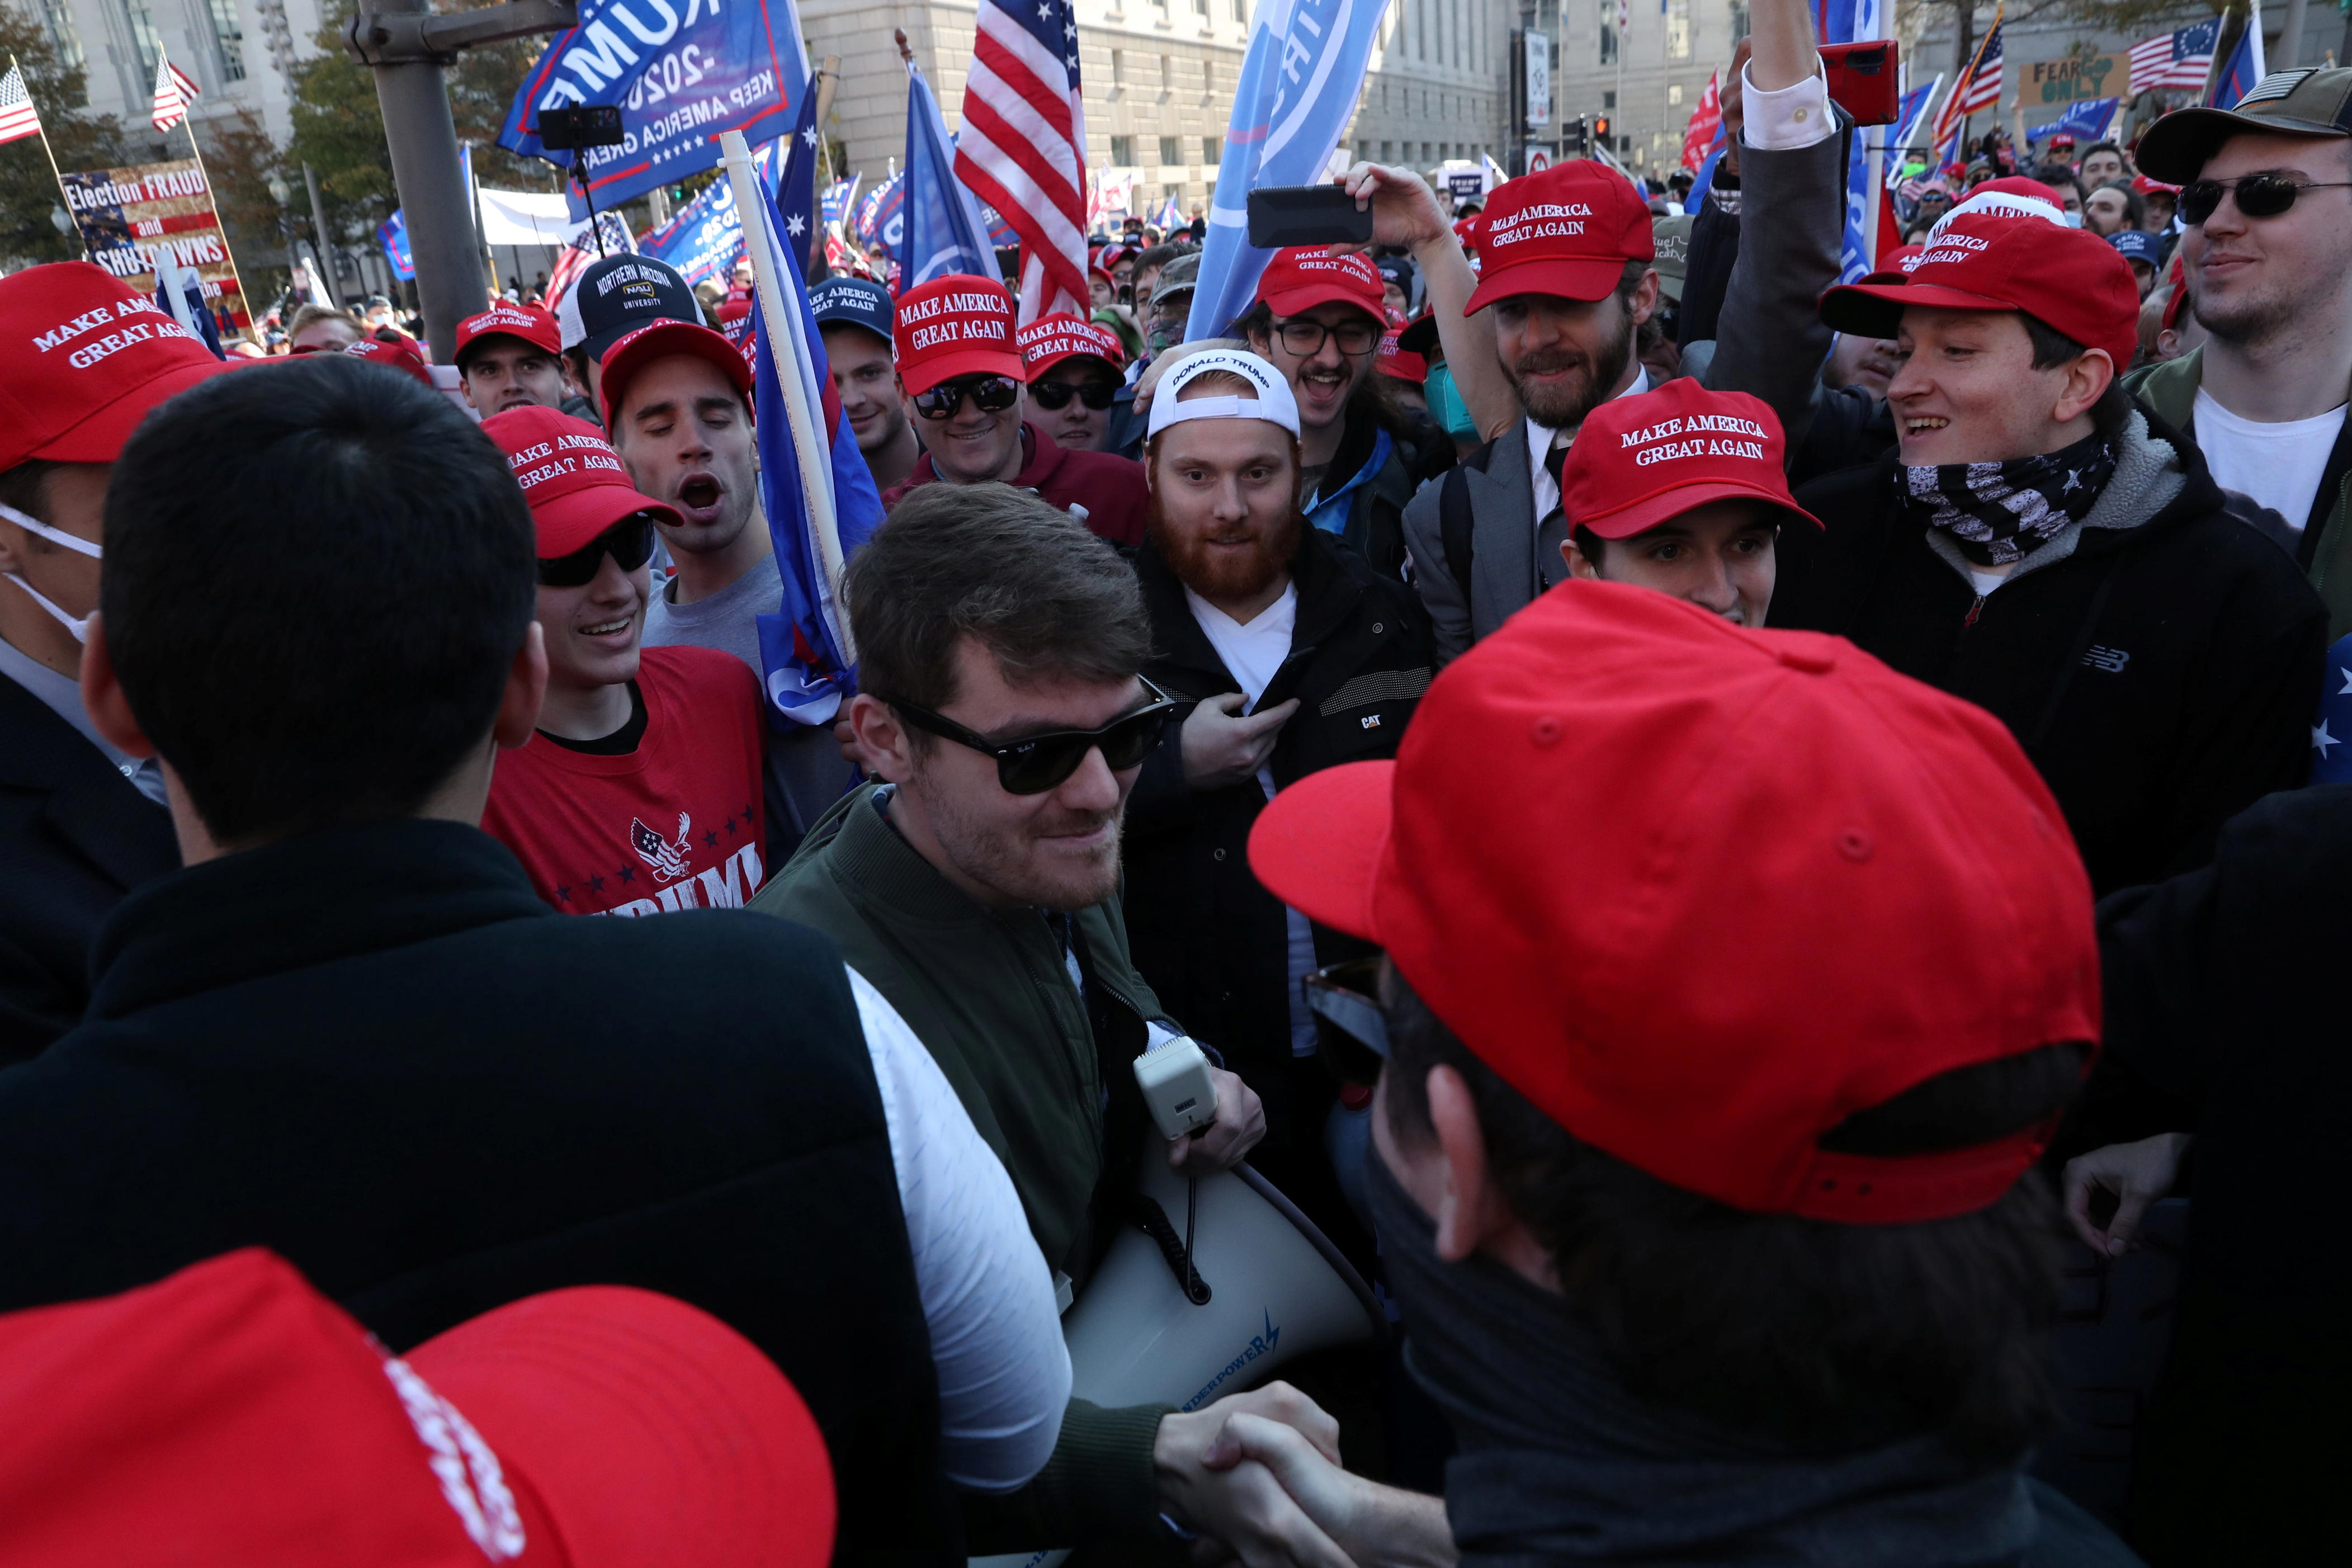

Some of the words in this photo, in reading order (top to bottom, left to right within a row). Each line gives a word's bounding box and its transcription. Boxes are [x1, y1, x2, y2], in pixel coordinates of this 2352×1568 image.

[2034, 61, 2080, 83] FEAR
[2042, 73, 2107, 102] ONLY
[64, 181, 143, 210] Election
[144, 169, 205, 199] FRAUD
[1519, 203, 1592, 221] AMERICA
[136, 216, 164, 237] and
[1493, 225, 1532, 247] GREAT
[1534, 221, 1584, 238] AGAIN
[1295, 250, 1328, 260] MAKE
[1338, 254, 1372, 276] MERICA
[1920, 250, 1969, 266] AGAIN
[597, 264, 638, 297] NORTHERN
[637, 264, 672, 289] ARIZONA
[1299, 261, 1339, 270] GREAT
[1342, 265, 1370, 284] AGAIN
[626, 285, 651, 294] NAU
[829, 287, 879, 303] AMERICA
[493, 308, 537, 321] AMERICA
[624, 298, 661, 309] UNIVERSITY
[812, 299, 834, 315] REAT
[840, 297, 875, 312] AGAIN
[900, 296, 941, 327] MAKE
[943, 293, 1009, 314] AMERICA
[32, 307, 114, 353] MAKE
[470, 317, 499, 333] GREAT
[500, 317, 533, 328] AGAIN
[912, 322, 959, 350] GREAT
[962, 320, 1005, 340] AGAIN
[1017, 323, 1055, 346] MAKE
[1057, 320, 1109, 348] AMERICA
[69, 323, 154, 369] GREAT
[155, 323, 197, 339] AGA
[1028, 338, 1069, 362] GREAT
[1379, 346, 1399, 356] AIN
[1173, 357, 1225, 386] DONALD
[1231, 358, 1269, 388] TRUMP
[1621, 419, 1682, 448] MAKE
[1685, 415, 1768, 438] AMERICA
[1636, 439, 1705, 466] GREAT
[1708, 439, 1763, 460] AGAIN
[517, 457, 577, 489] GREAT
[584, 455, 622, 473] AGAIN
[1362, 715, 1380, 729] CAT
[1181, 1336, 1269, 1413] NDERPOWER
